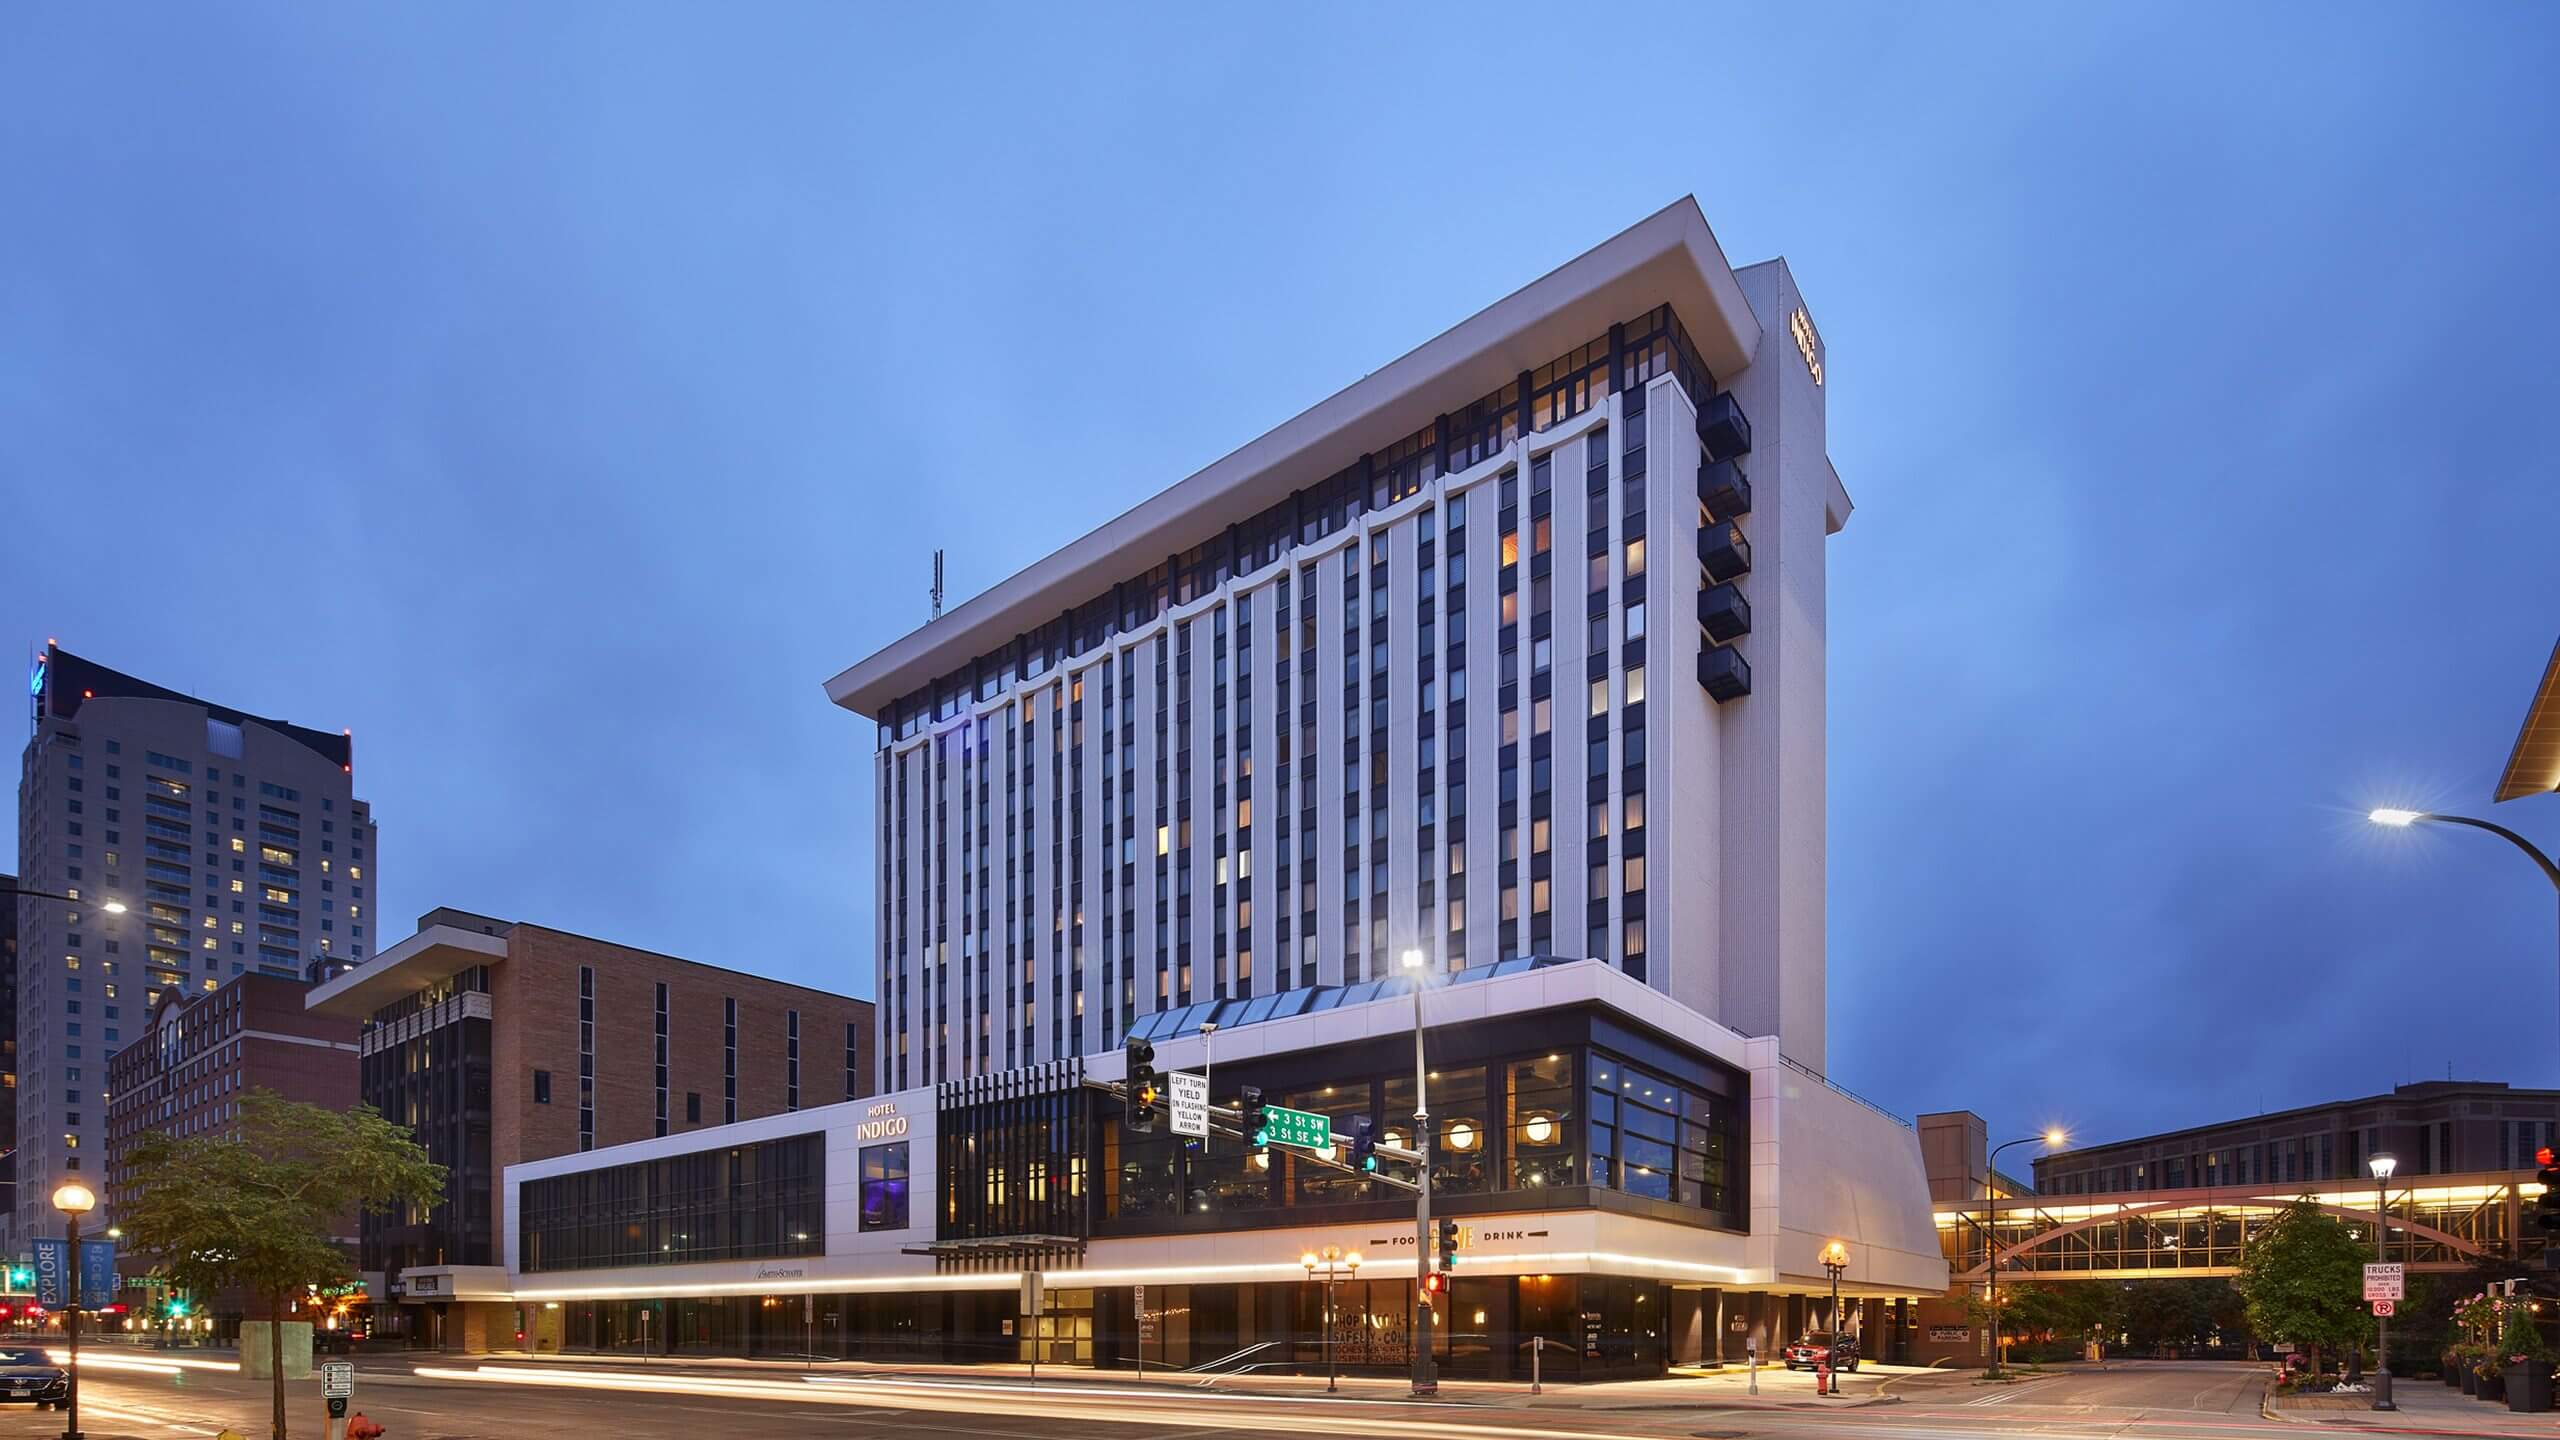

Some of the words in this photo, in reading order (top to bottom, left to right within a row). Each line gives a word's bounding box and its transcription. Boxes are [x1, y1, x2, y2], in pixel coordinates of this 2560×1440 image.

[1790, 311, 1821, 386] INDIGO
[1171, 1075, 1186, 1085] LEFT
[1190, 1079, 1206, 1088] TURN
[1178, 1088, 1200, 1100] YIELD
[868, 1103, 896, 1117] HOTEL
[1181, 1101, 1207, 1112] FLASHING
[1177, 1110, 1202, 1121] YELLOW
[857, 1116, 908, 1140] INDIGO
[1179, 1121, 1201, 1131] ARROW
[1284, 1113, 1290, 1125] 3
[1295, 1115, 1306, 1127] St
[1310, 1118, 1324, 1131] SW
[1269, 1125, 1276, 1137] 3
[1281, 1127, 1292, 1140] St
[1297, 1130, 1309, 1143] SE
[1392, 1236, 1416, 1246] FOO
[1484, 1230, 1524, 1241] DRINK
[39, 1243, 56, 1305] EXPLORE
[2366, 1265, 2401, 1274] TRUCKS
